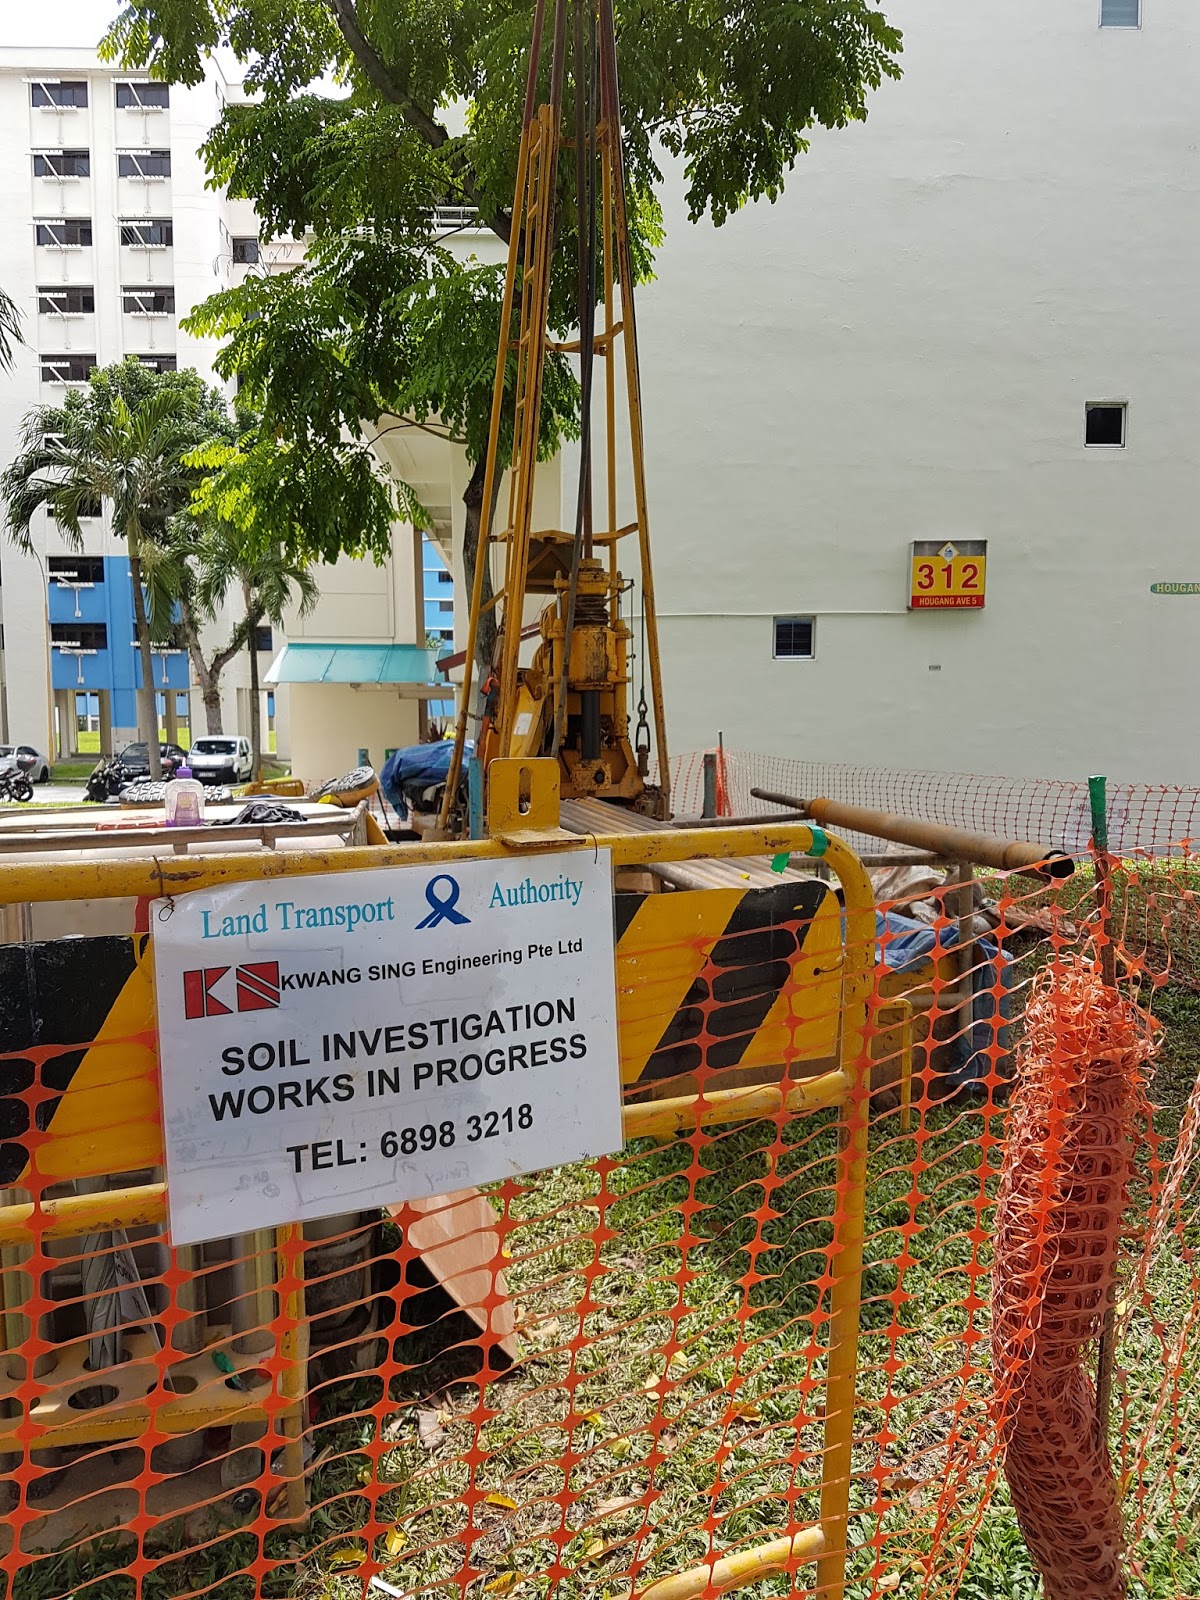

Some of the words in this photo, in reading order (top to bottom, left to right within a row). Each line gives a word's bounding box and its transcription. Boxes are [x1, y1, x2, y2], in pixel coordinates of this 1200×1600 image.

[917, 563, 979, 590] 312
[919, 597, 955, 605] HOUGANG
[956, 597, 970, 605] AVE
[201, 904, 268, 939] Land
[275, 896, 395, 933] Transport
[488, 874, 584, 908] Authority
[281, 967, 362, 991] KWANG
[368, 962, 416, 981] SING
[422, 949, 522, 975] Engineering
[528, 944, 553, 959] Pte
[558, 938, 583, 955] Ltd
[221, 1039, 310, 1076] SOIL
[323, 997, 576, 1062] INVESTIGATION
[208, 1073, 355, 1122] WORKS
[367, 1067, 400, 1097] IN
[413, 1033, 587, 1091] PROGRESS
[286, 1139, 366, 1173] TEL:
[380, 1121, 456, 1159] 6898
[466, 1103, 533, 1142] 3218
